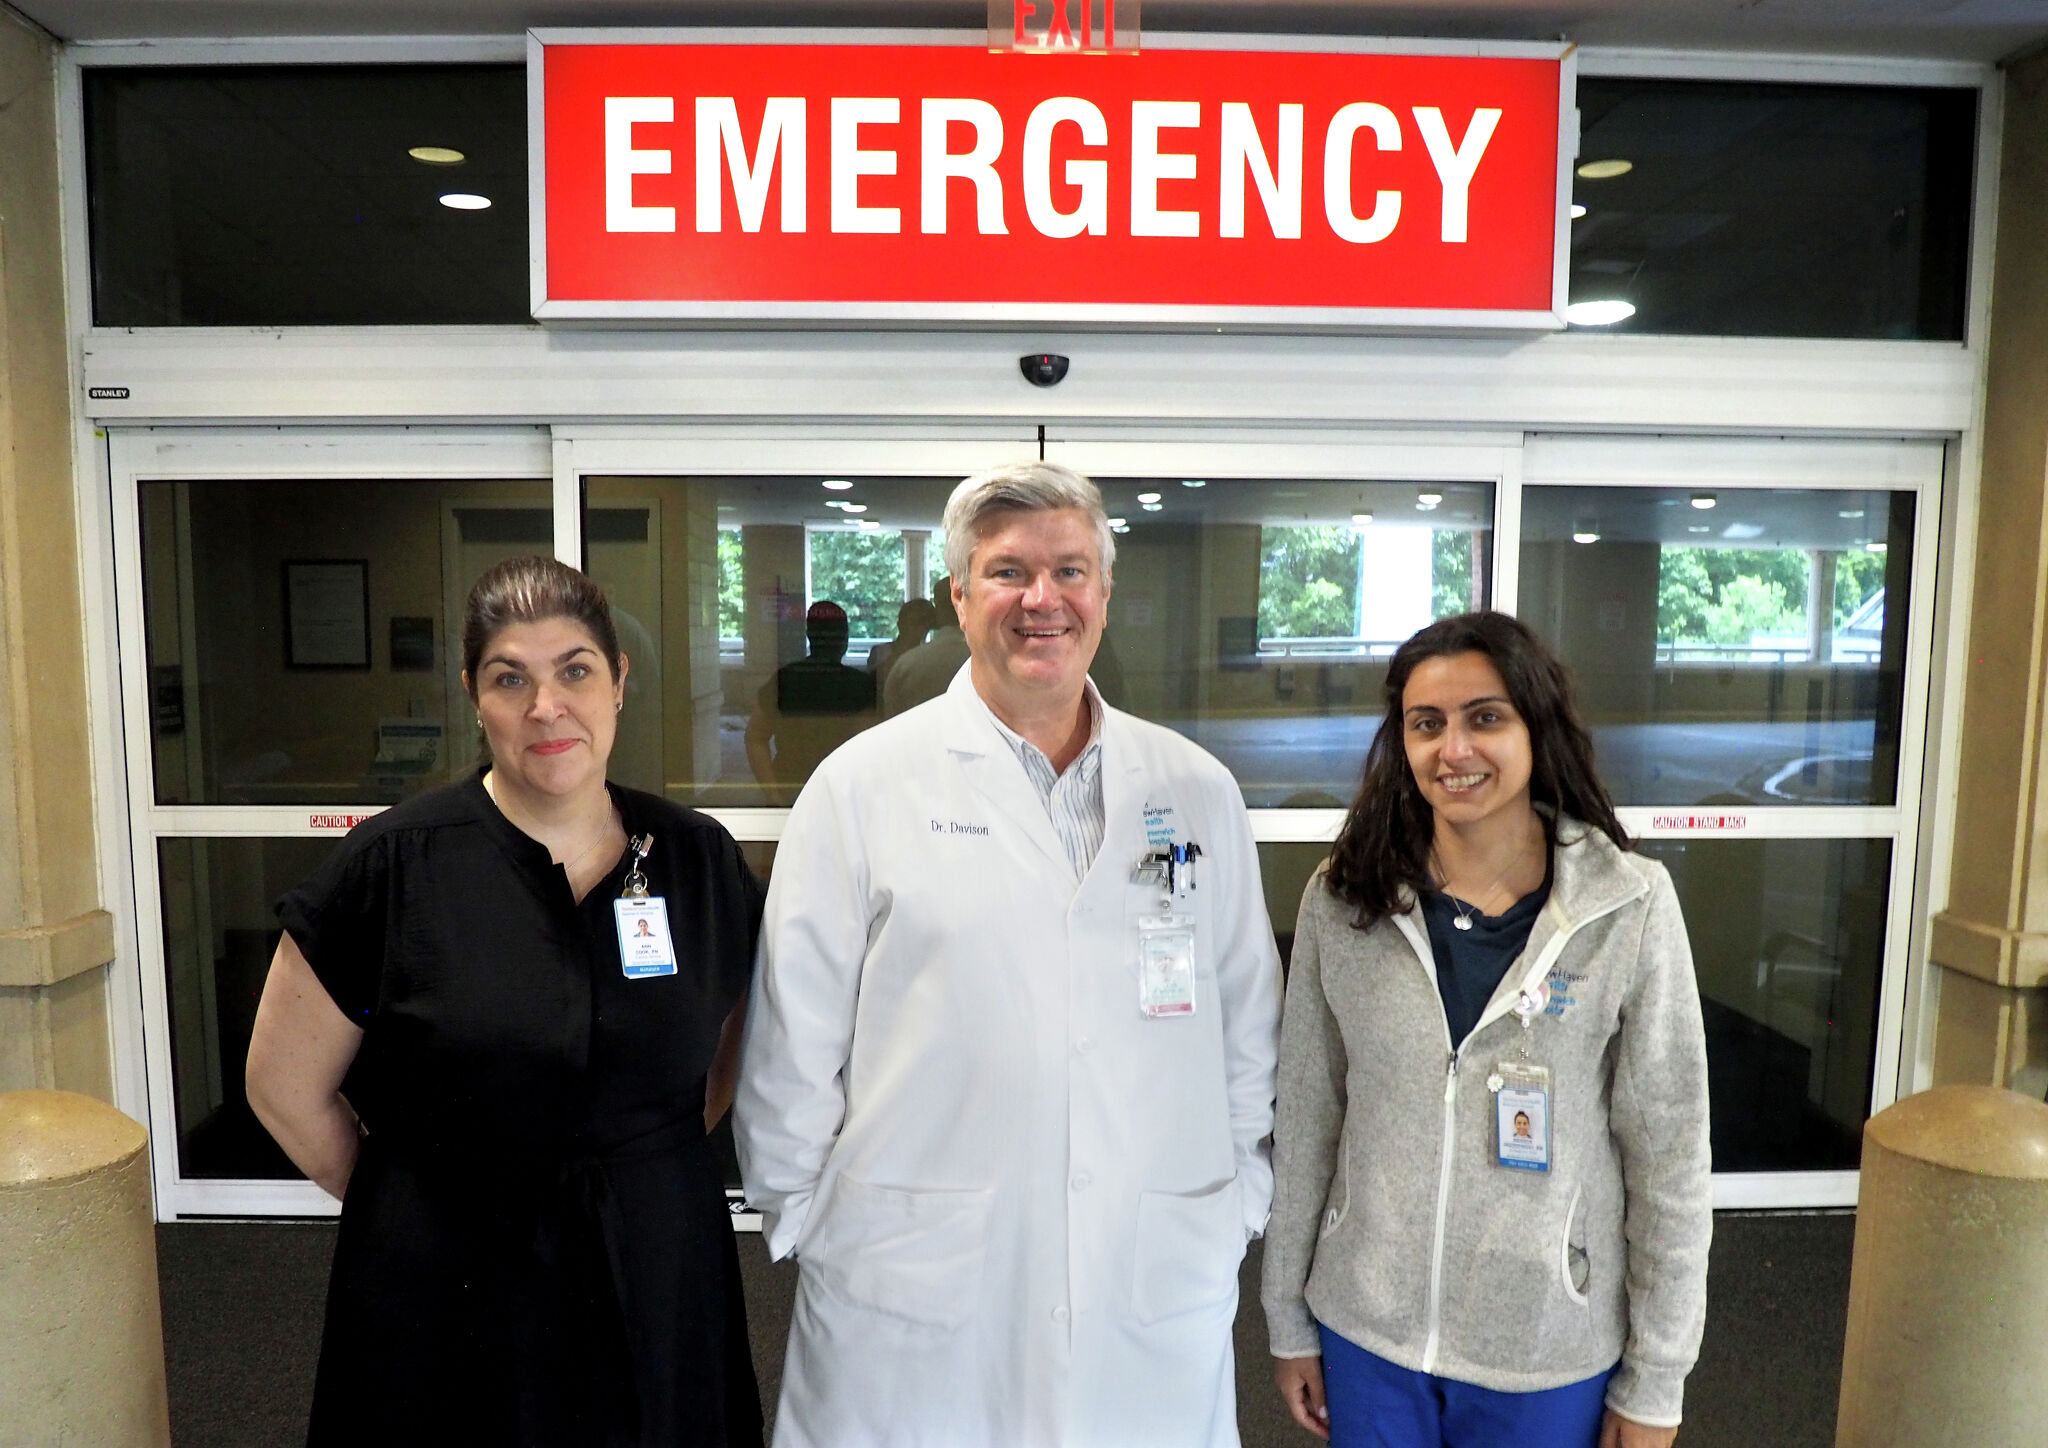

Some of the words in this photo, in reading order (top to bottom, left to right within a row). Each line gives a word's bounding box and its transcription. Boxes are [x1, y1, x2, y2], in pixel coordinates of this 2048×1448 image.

[603, 95, 1504, 244] EMERGENCY
[91, 389, 127, 397] STANLEY
[310, 816, 347, 827] CAUTION
[931, 819, 947, 833] Dr.
[950, 821, 989, 836] Davison
[1654, 816, 1688, 828] CAUTION
[1693, 816, 1720, 828] STAND
[1724, 816, 1746, 828] BACK
